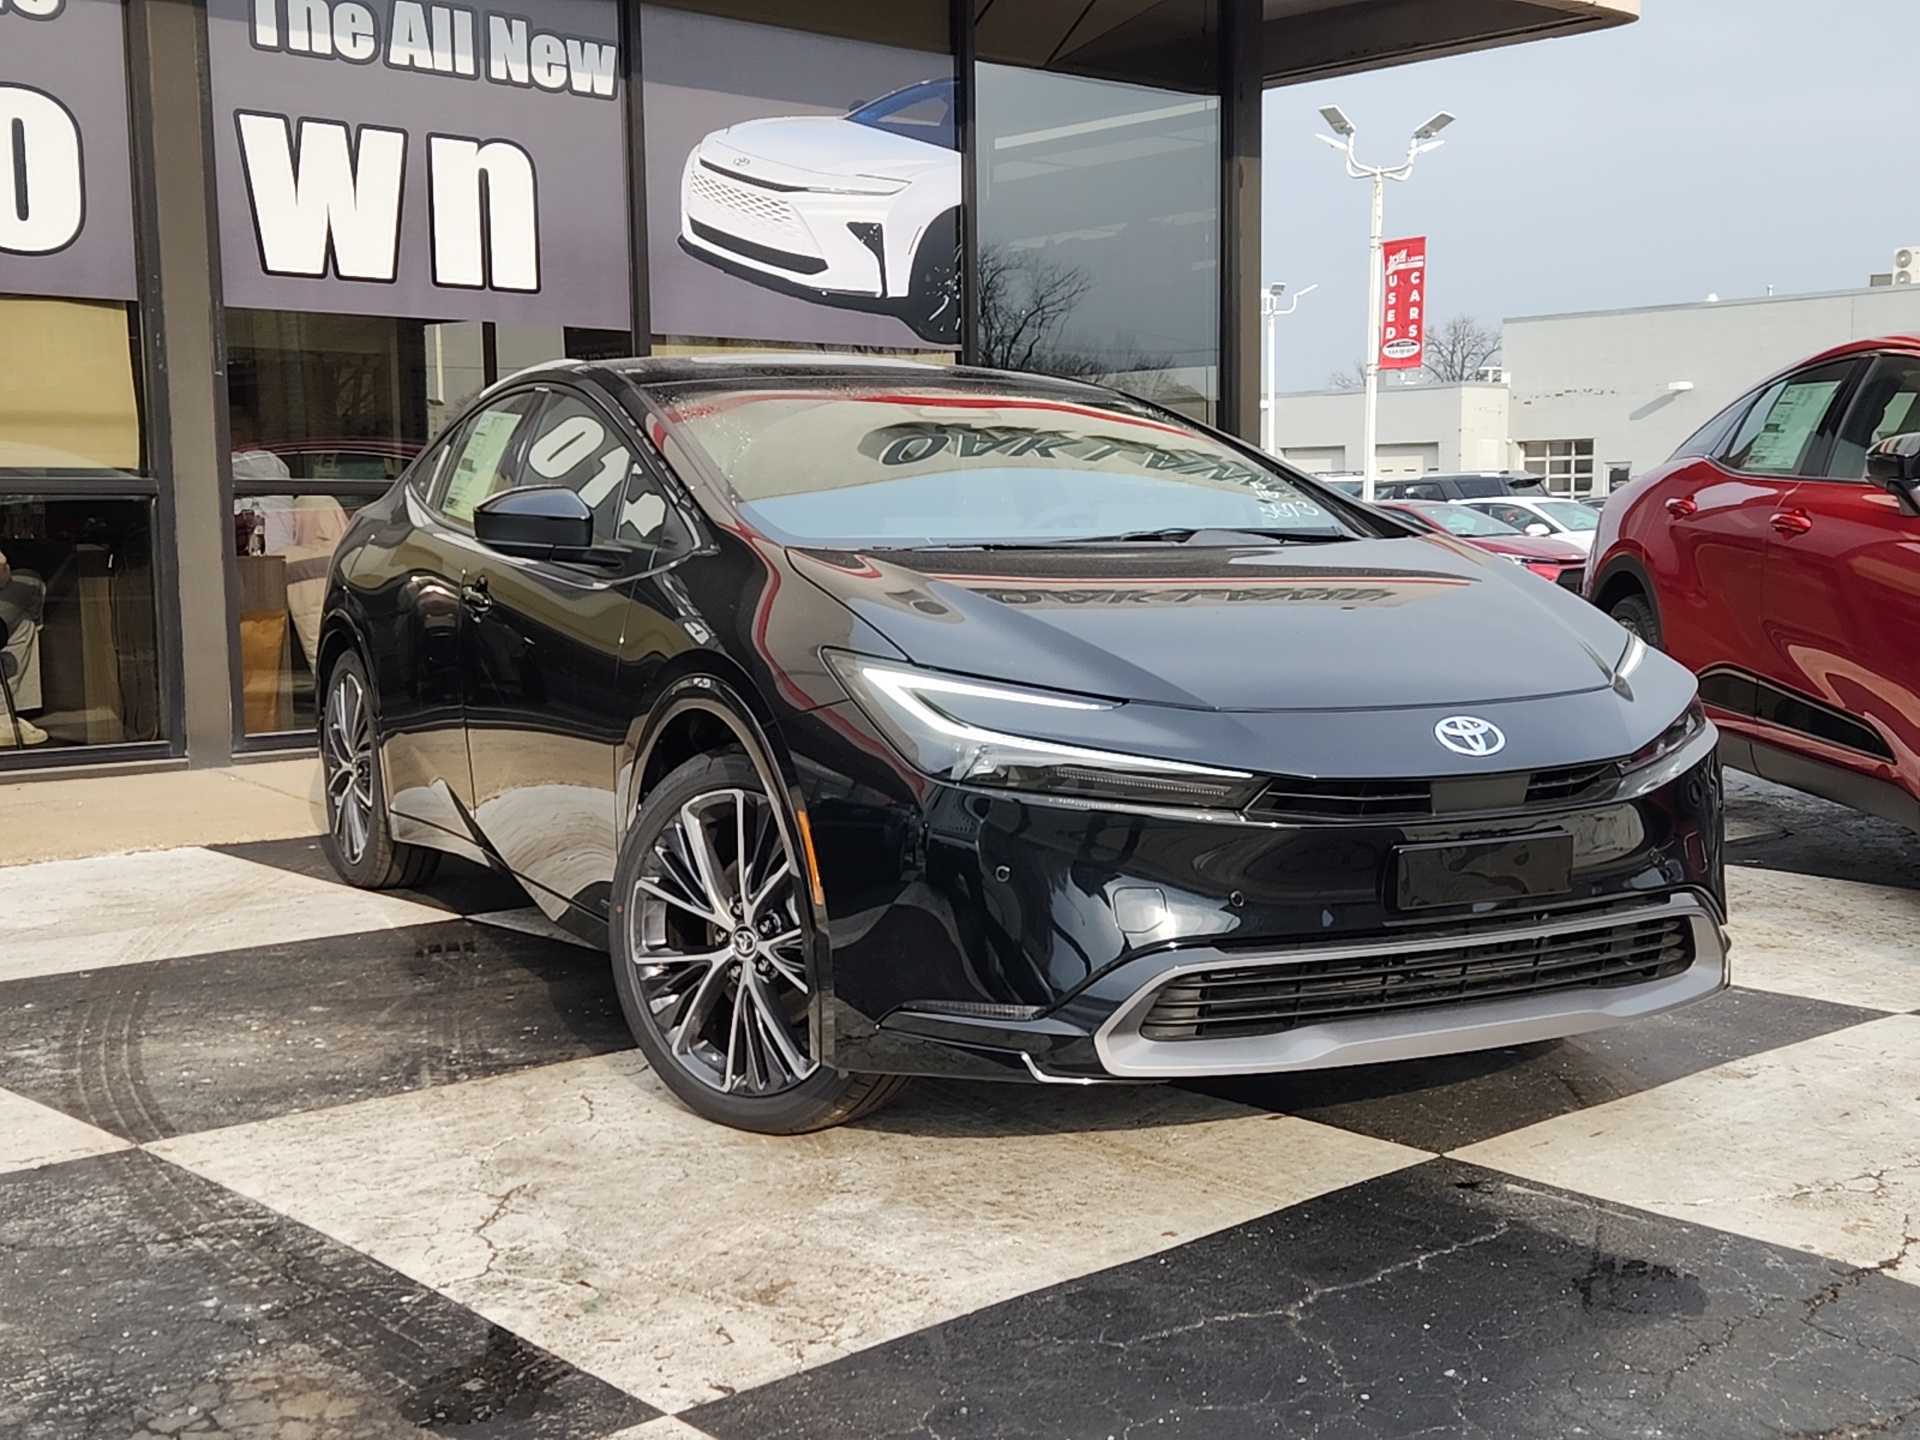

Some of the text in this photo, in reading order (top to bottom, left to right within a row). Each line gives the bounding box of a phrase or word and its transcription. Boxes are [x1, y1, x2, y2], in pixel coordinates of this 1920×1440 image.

[387, 0, 476, 78] All
[487, 12, 618, 98] New
[1386, 275, 1398, 339] USED
[1409, 271, 1421, 337] CARS
